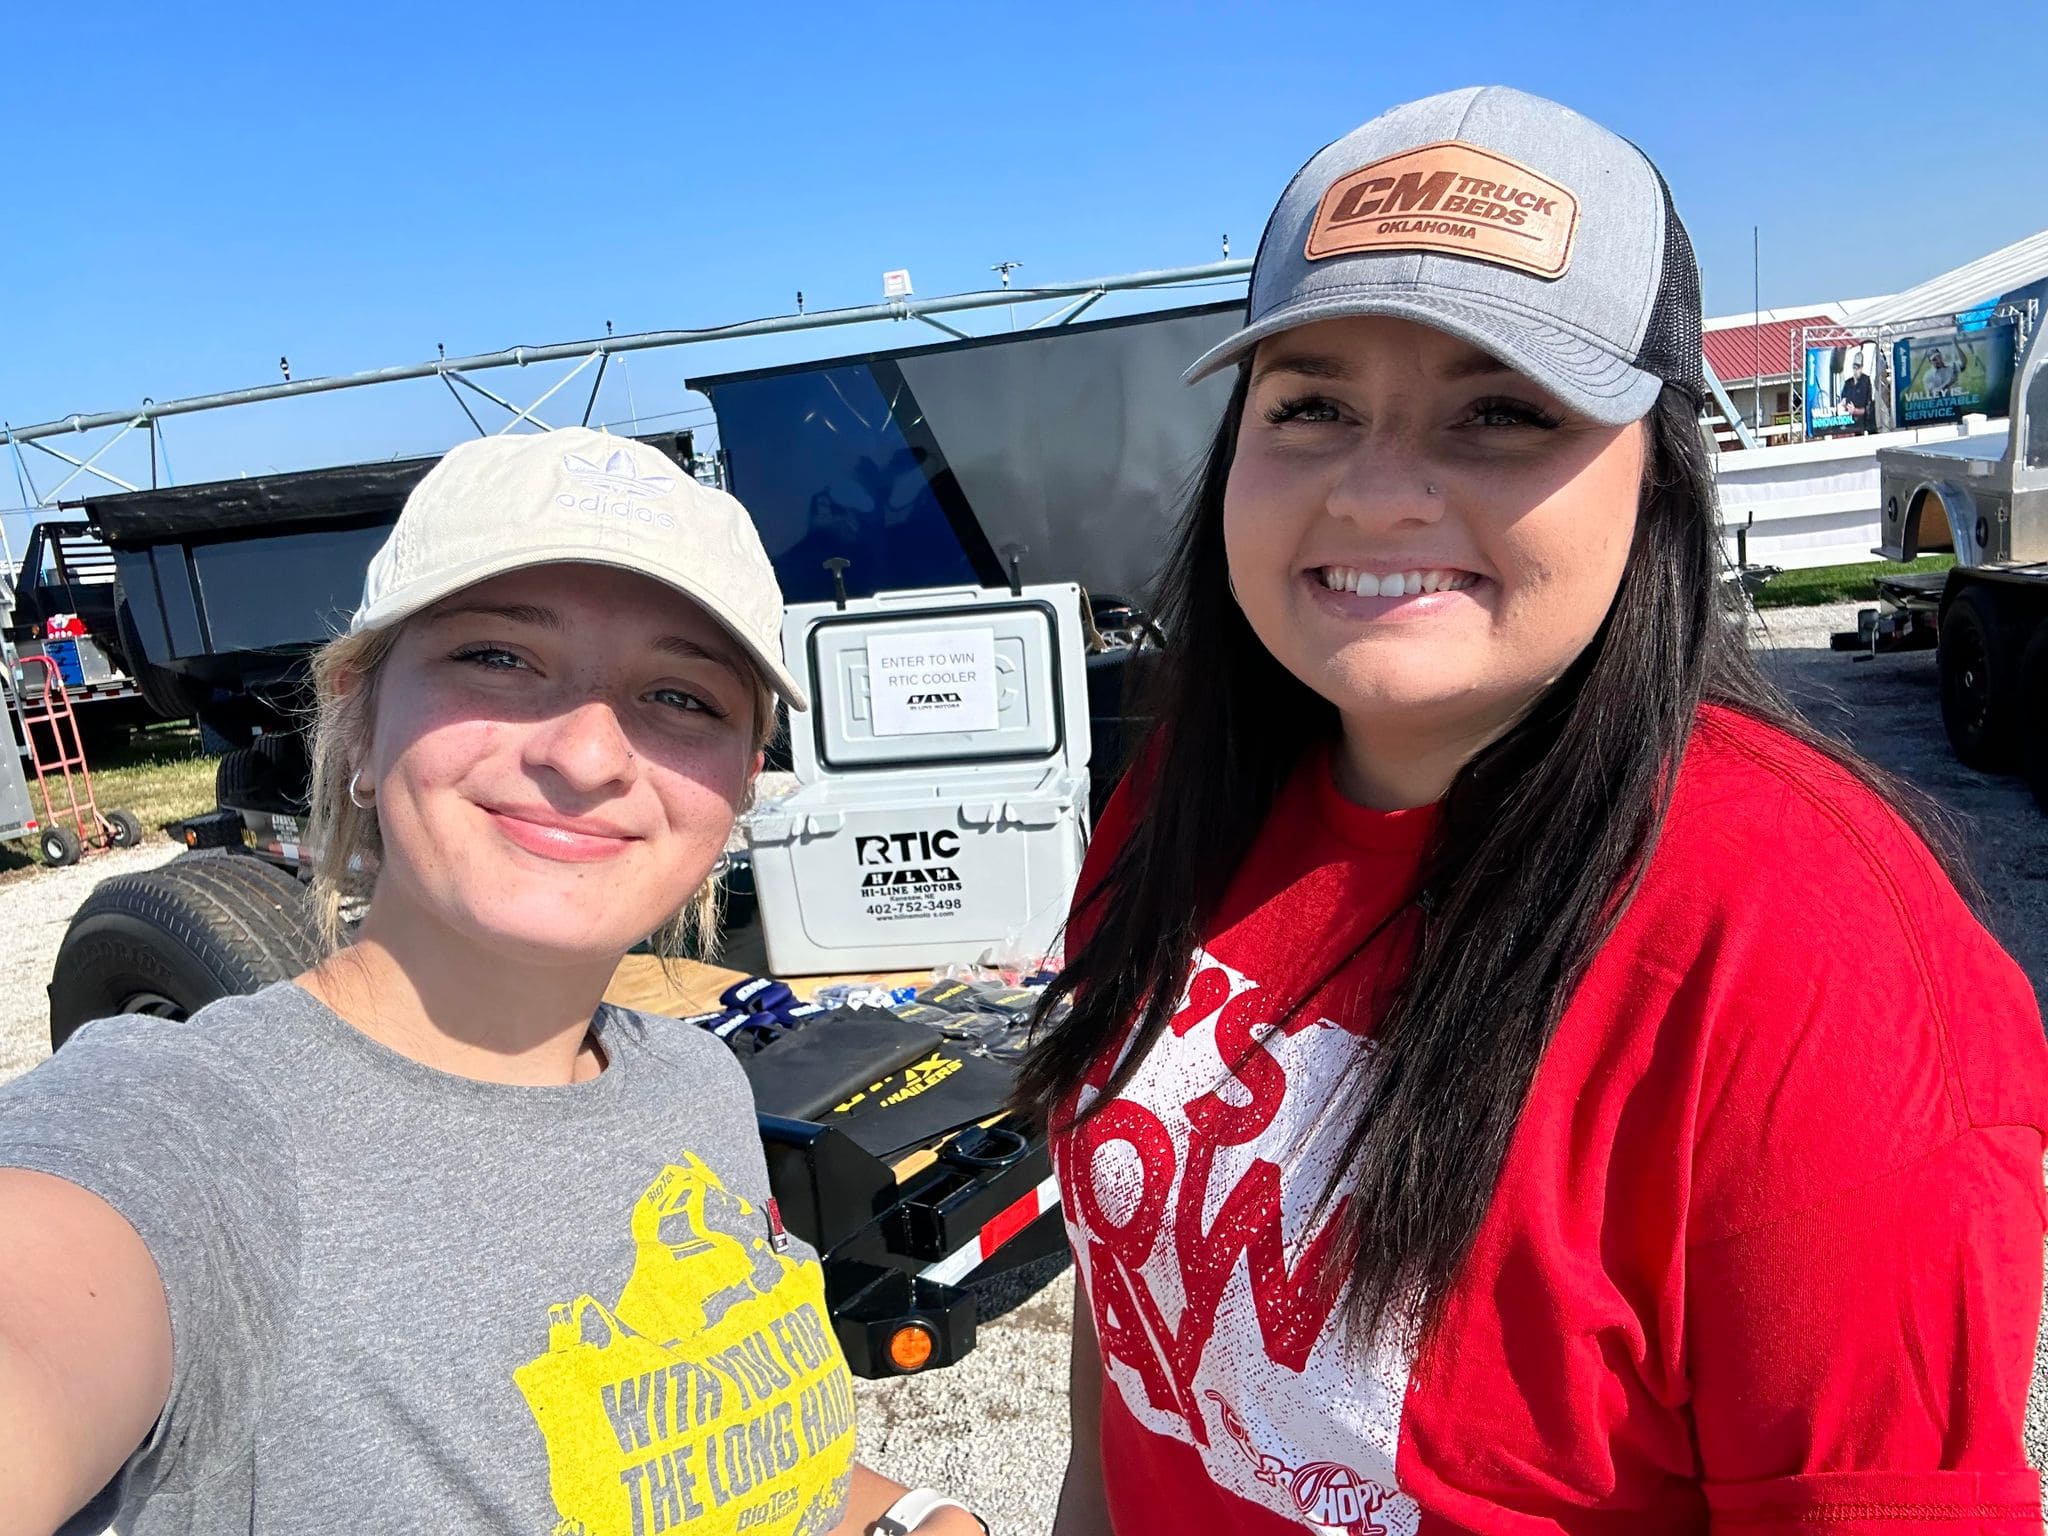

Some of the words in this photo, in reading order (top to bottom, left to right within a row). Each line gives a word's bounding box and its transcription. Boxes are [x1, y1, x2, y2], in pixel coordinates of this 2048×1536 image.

[1330, 171, 1459, 223] CM
[1456, 175, 1559, 217] TRUCK
[1441, 195, 1529, 227] BEDS
[1376, 220, 1477, 240] OKLAHOMA
[1905, 388, 1949, 402] VALLEY
[1905, 394, 1980, 411] UNBEATABLE
[1905, 407, 1956, 420] SERVICE.
[555, 493, 676, 529] adidas
[881, 656, 925, 669] ENTER
[929, 654, 947, 666] TO
[950, 653, 975, 665] WIN
[888, 675, 918, 687] RTIC
[922, 671, 977, 685] COOLER
[855, 829, 962, 866] RTIC
[861, 886, 909, 897] HI-LINE
[913, 882, 962, 894] MOTORS
[866, 899, 962, 915] 402-752-3498
[601, 1361, 723, 1455] WITH
[706, 1330, 793, 1411] YOU
[768, 1302, 833, 1377] FOR
[620, 1443, 704, 1536] THE
[705, 1400, 800, 1508] LONG
